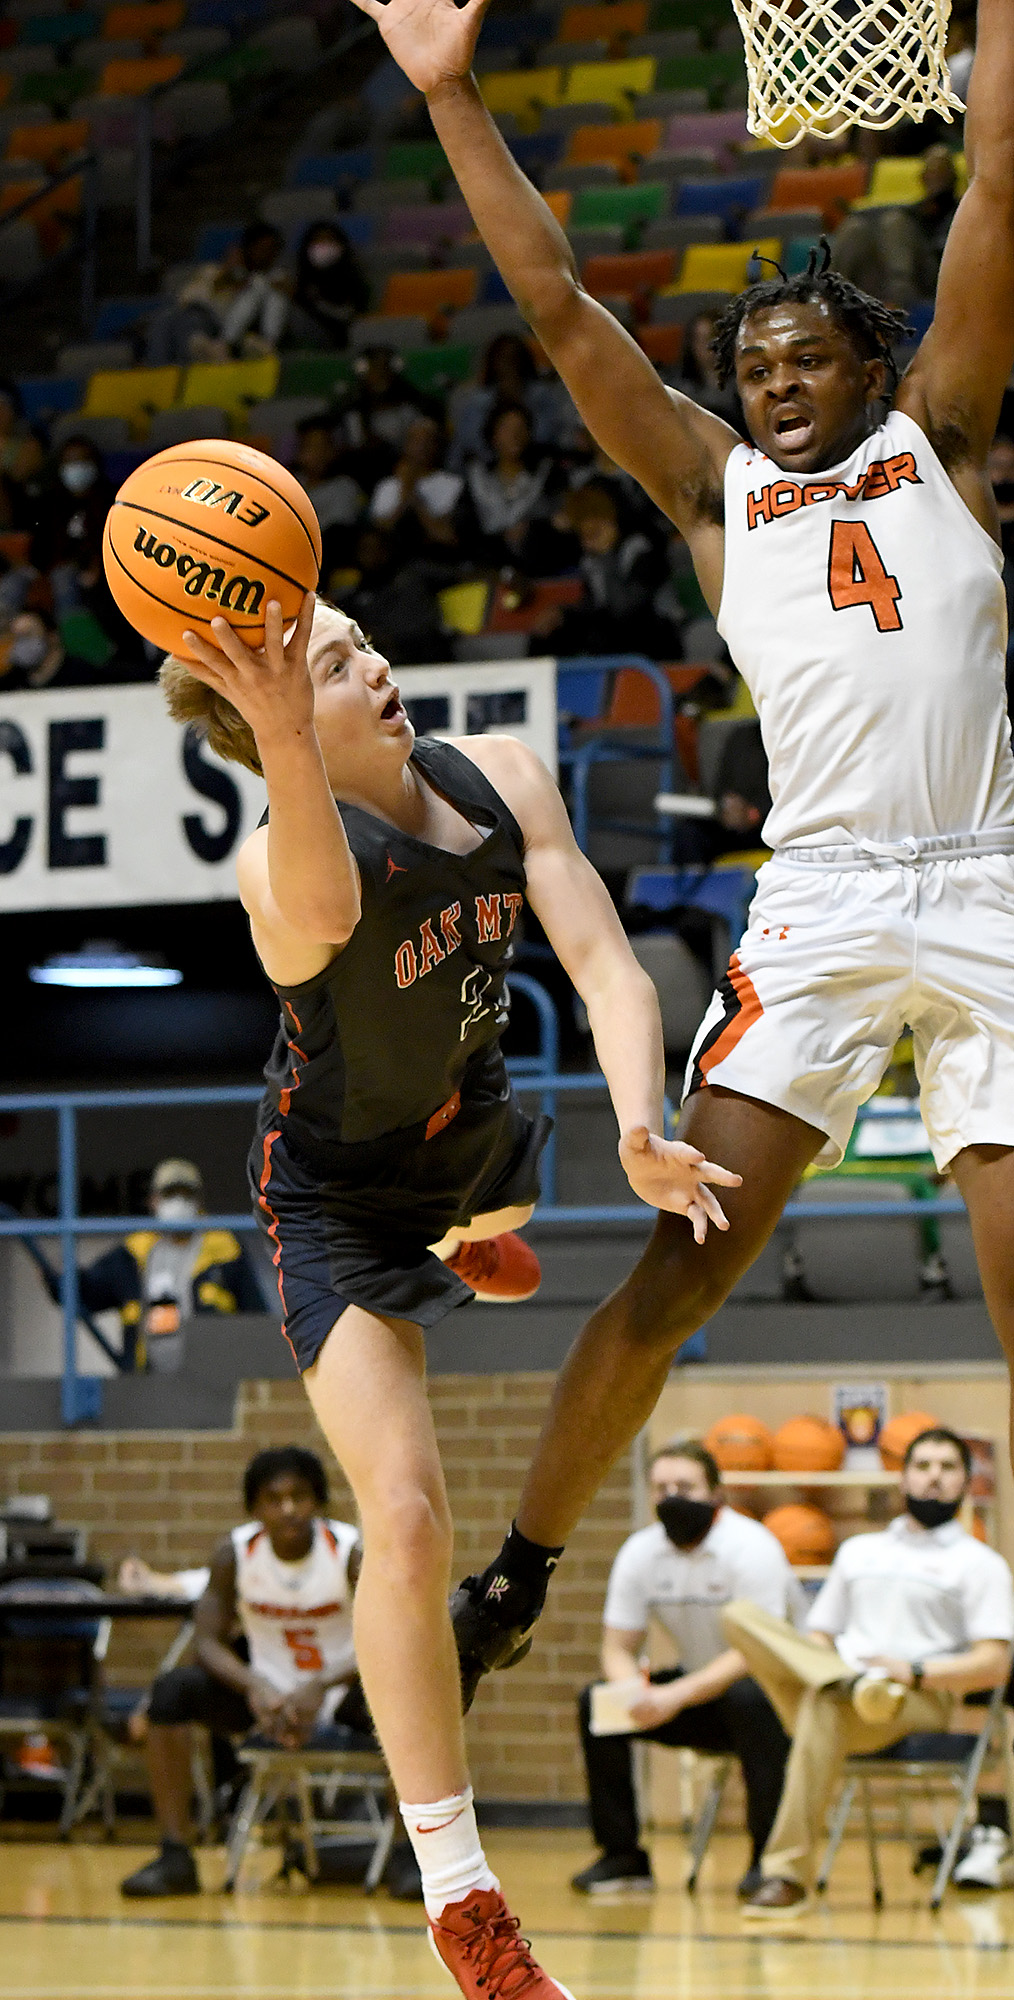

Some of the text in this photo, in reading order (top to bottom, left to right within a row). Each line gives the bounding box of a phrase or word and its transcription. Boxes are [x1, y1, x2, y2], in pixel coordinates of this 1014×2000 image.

[747, 452, 925, 532] HOOVER
[133, 522, 266, 616] Wilson
[828, 519, 903, 633] 4
[394, 901, 463, 989] OAK
[283, 1627, 325, 1672] 5
